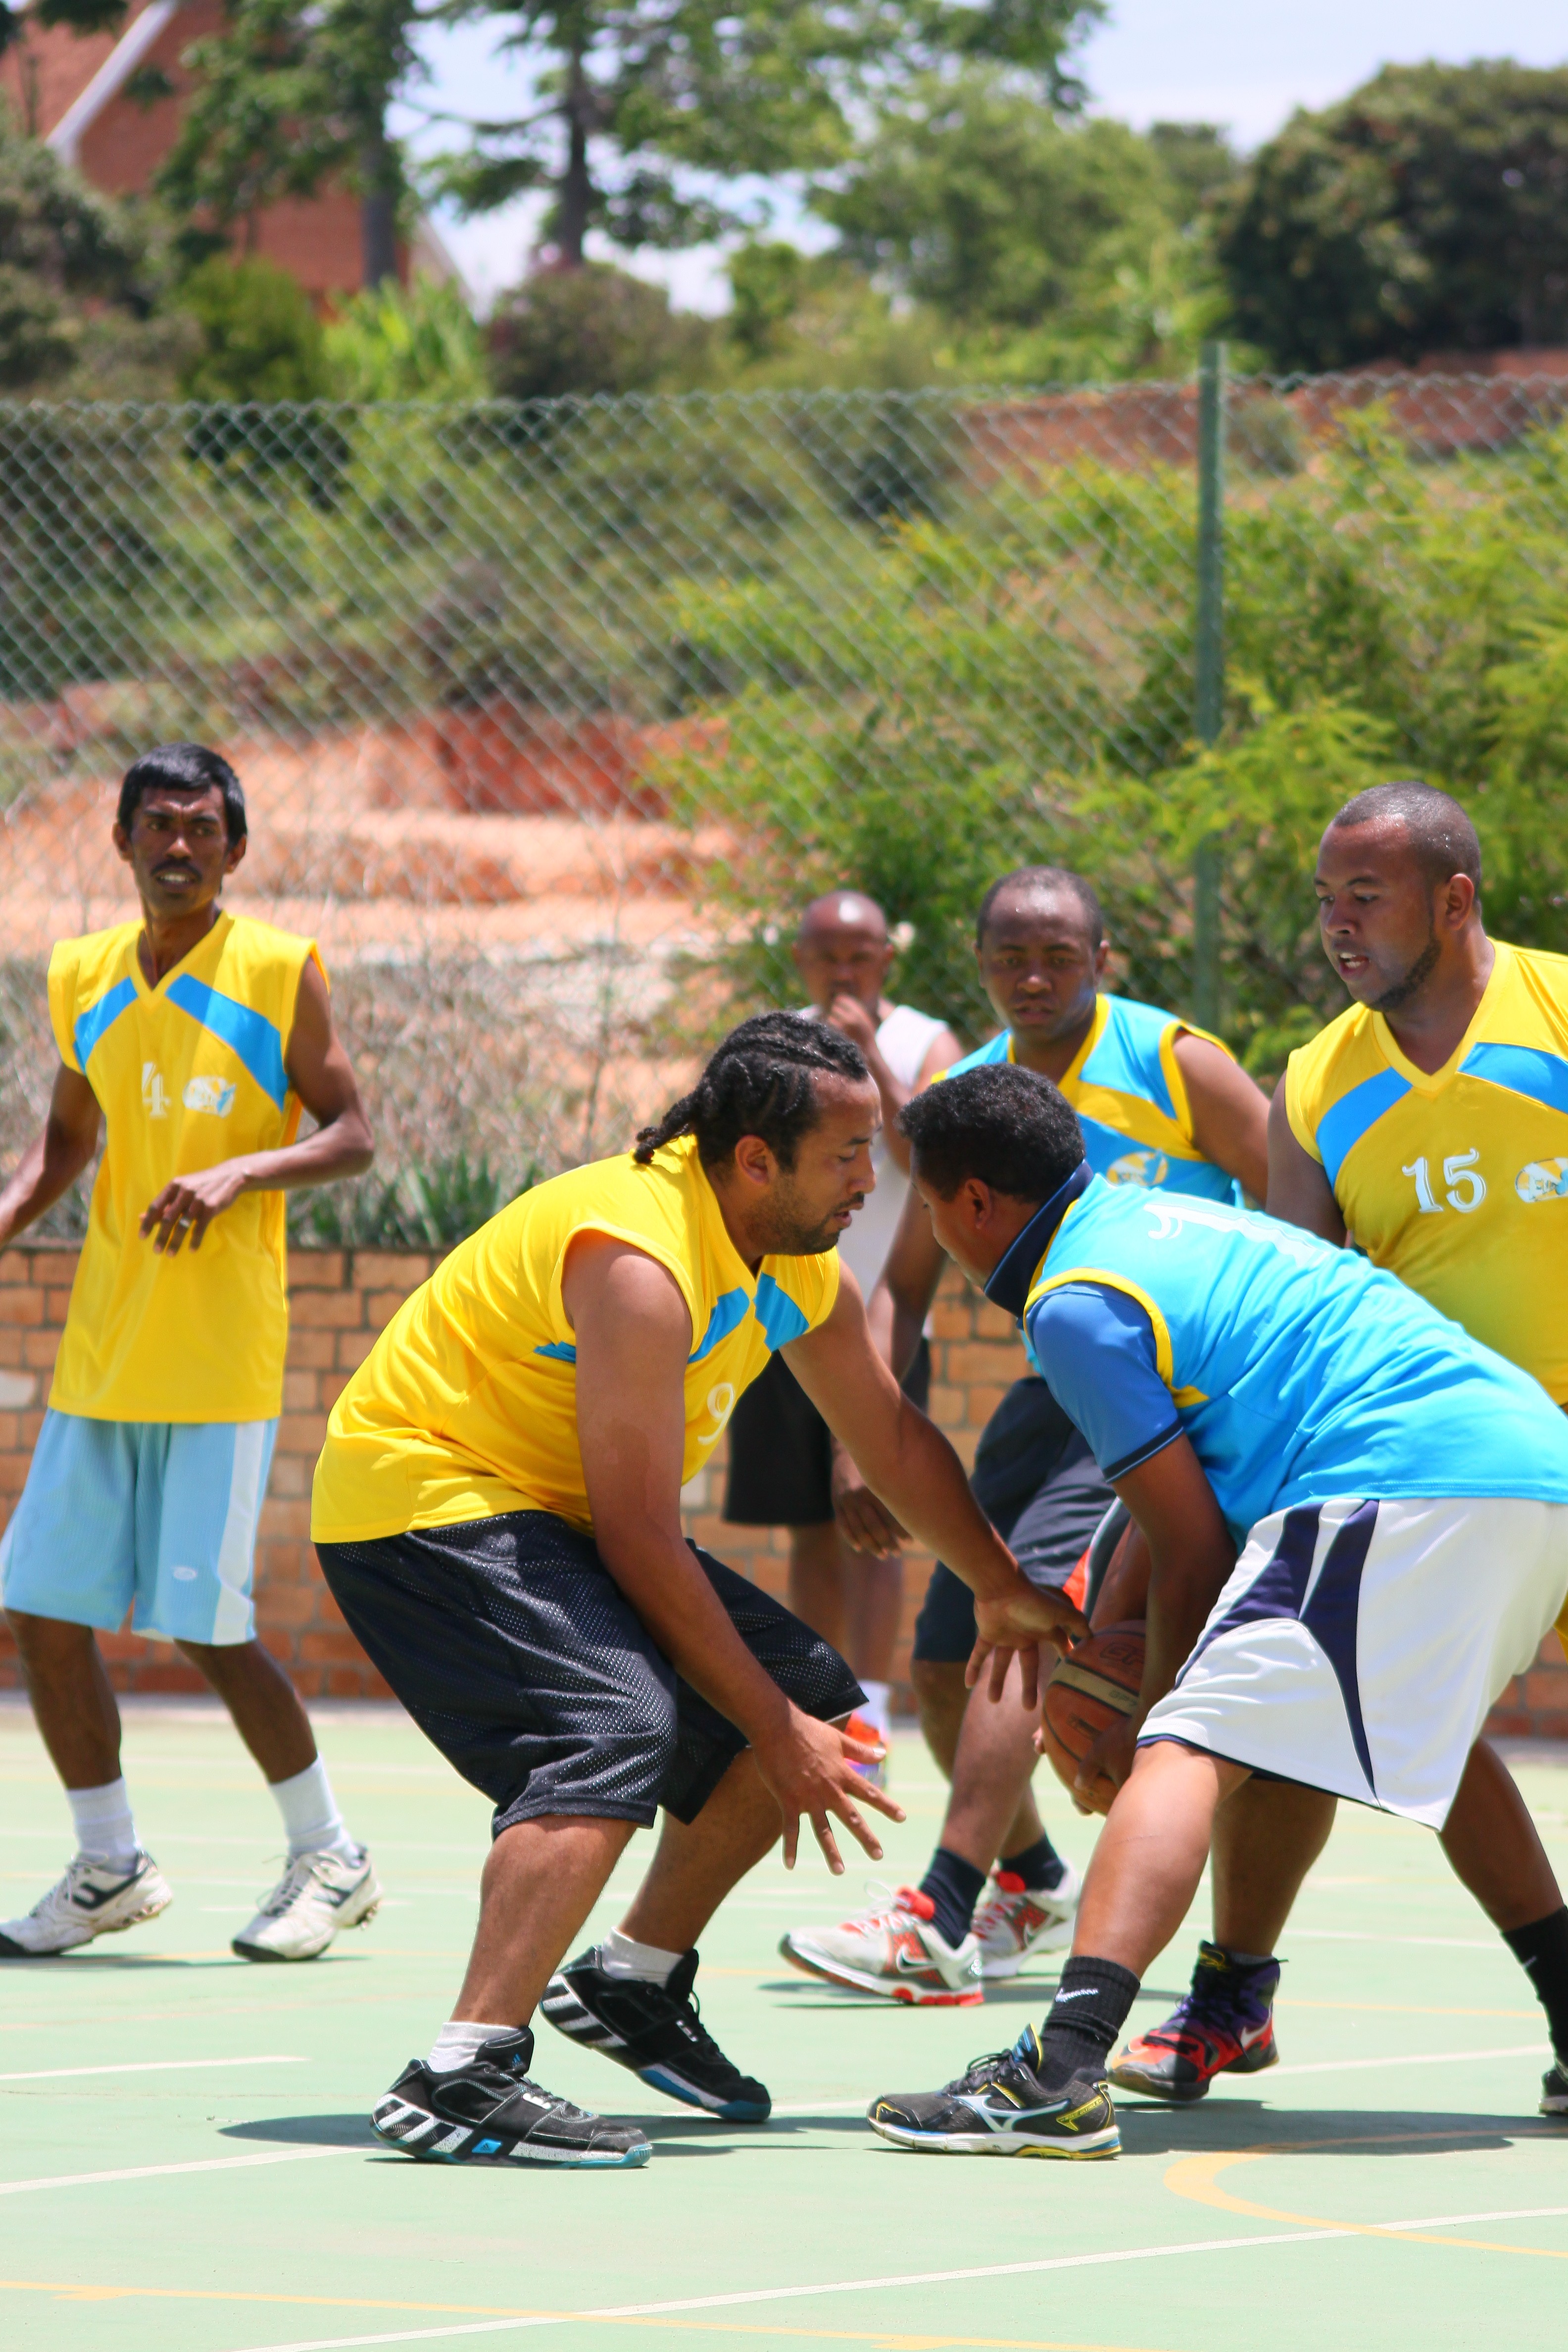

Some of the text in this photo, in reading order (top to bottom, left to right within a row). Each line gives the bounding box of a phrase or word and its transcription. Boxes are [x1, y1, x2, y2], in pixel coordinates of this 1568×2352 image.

[141, 1061, 171, 1120] 4
[1401, 1147, 1486, 1213] 15
[697, 1382, 735, 1445] 9
